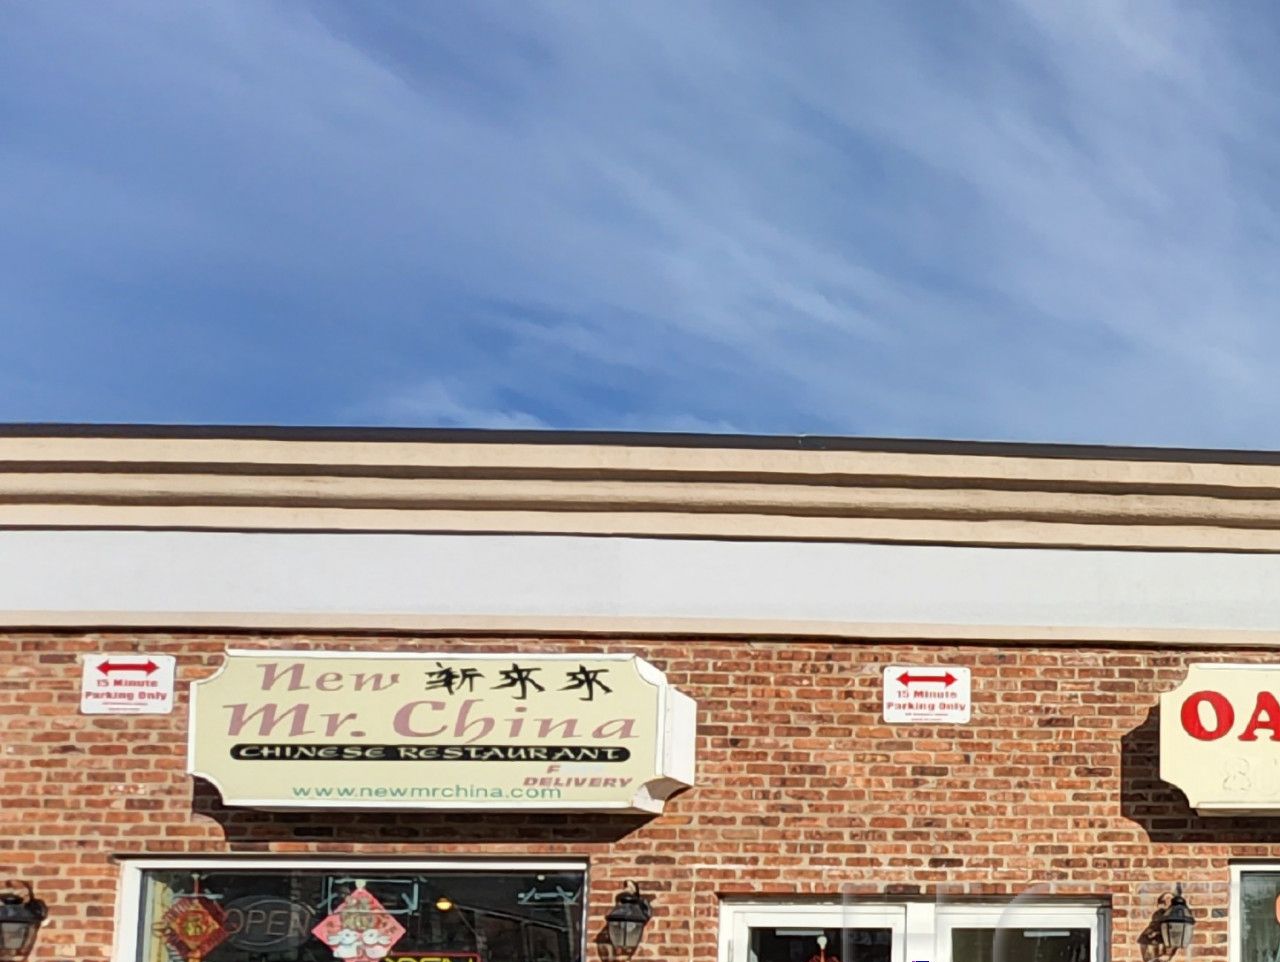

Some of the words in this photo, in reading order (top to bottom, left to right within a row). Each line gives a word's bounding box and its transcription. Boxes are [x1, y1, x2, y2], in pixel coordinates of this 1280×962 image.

[256, 662, 400, 691] New
[97, 679, 109, 687] 15
[113, 679, 158, 687] Minute
[85, 691, 134, 700] Parking
[138, 691, 167, 700] Only
[897, 690, 909, 698] 15
[914, 690, 957, 698] Minute
[886, 702, 935, 711] Parking
[939, 702, 966, 711] Only
[222, 703, 366, 737] Mr.
[393, 699, 640, 743] China
[239, 746, 386, 759] CHINESE
[398, 747, 620, 760] RESTAURANT
[523, 777, 633, 788] DELIVERY
[292, 784, 562, 799] www.newmrchina.com
